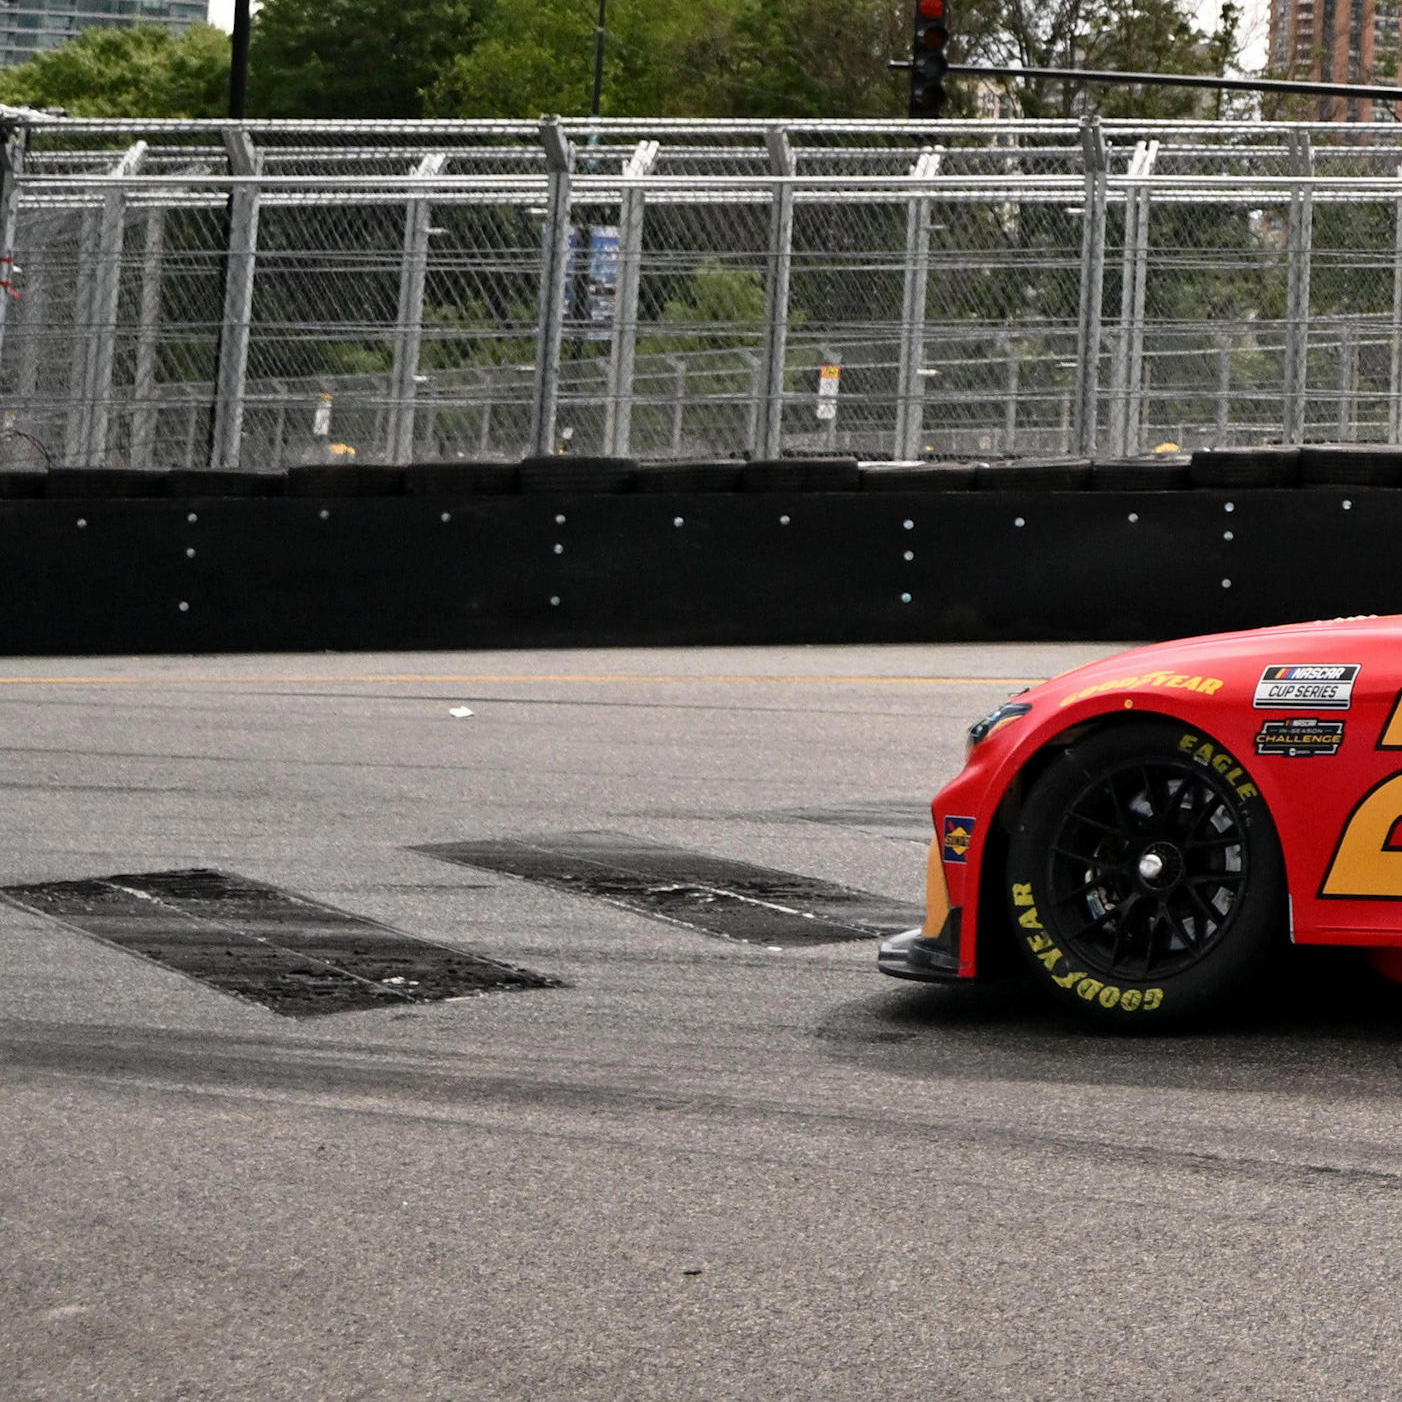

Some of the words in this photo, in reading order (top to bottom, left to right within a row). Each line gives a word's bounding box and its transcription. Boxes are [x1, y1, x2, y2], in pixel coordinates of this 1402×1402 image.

[1291, 667, 1346, 679] NASCAR
[1060, 671, 1223, 707] GOODYEAR
[1268, 685, 1295, 697] CUP
[1294, 685, 1339, 698] SERIES
[1256, 735, 1341, 743] CHALLENGE
[1178, 734, 1259, 802] EAGLE
[1012, 882, 1164, 1011] GOODYEAR
